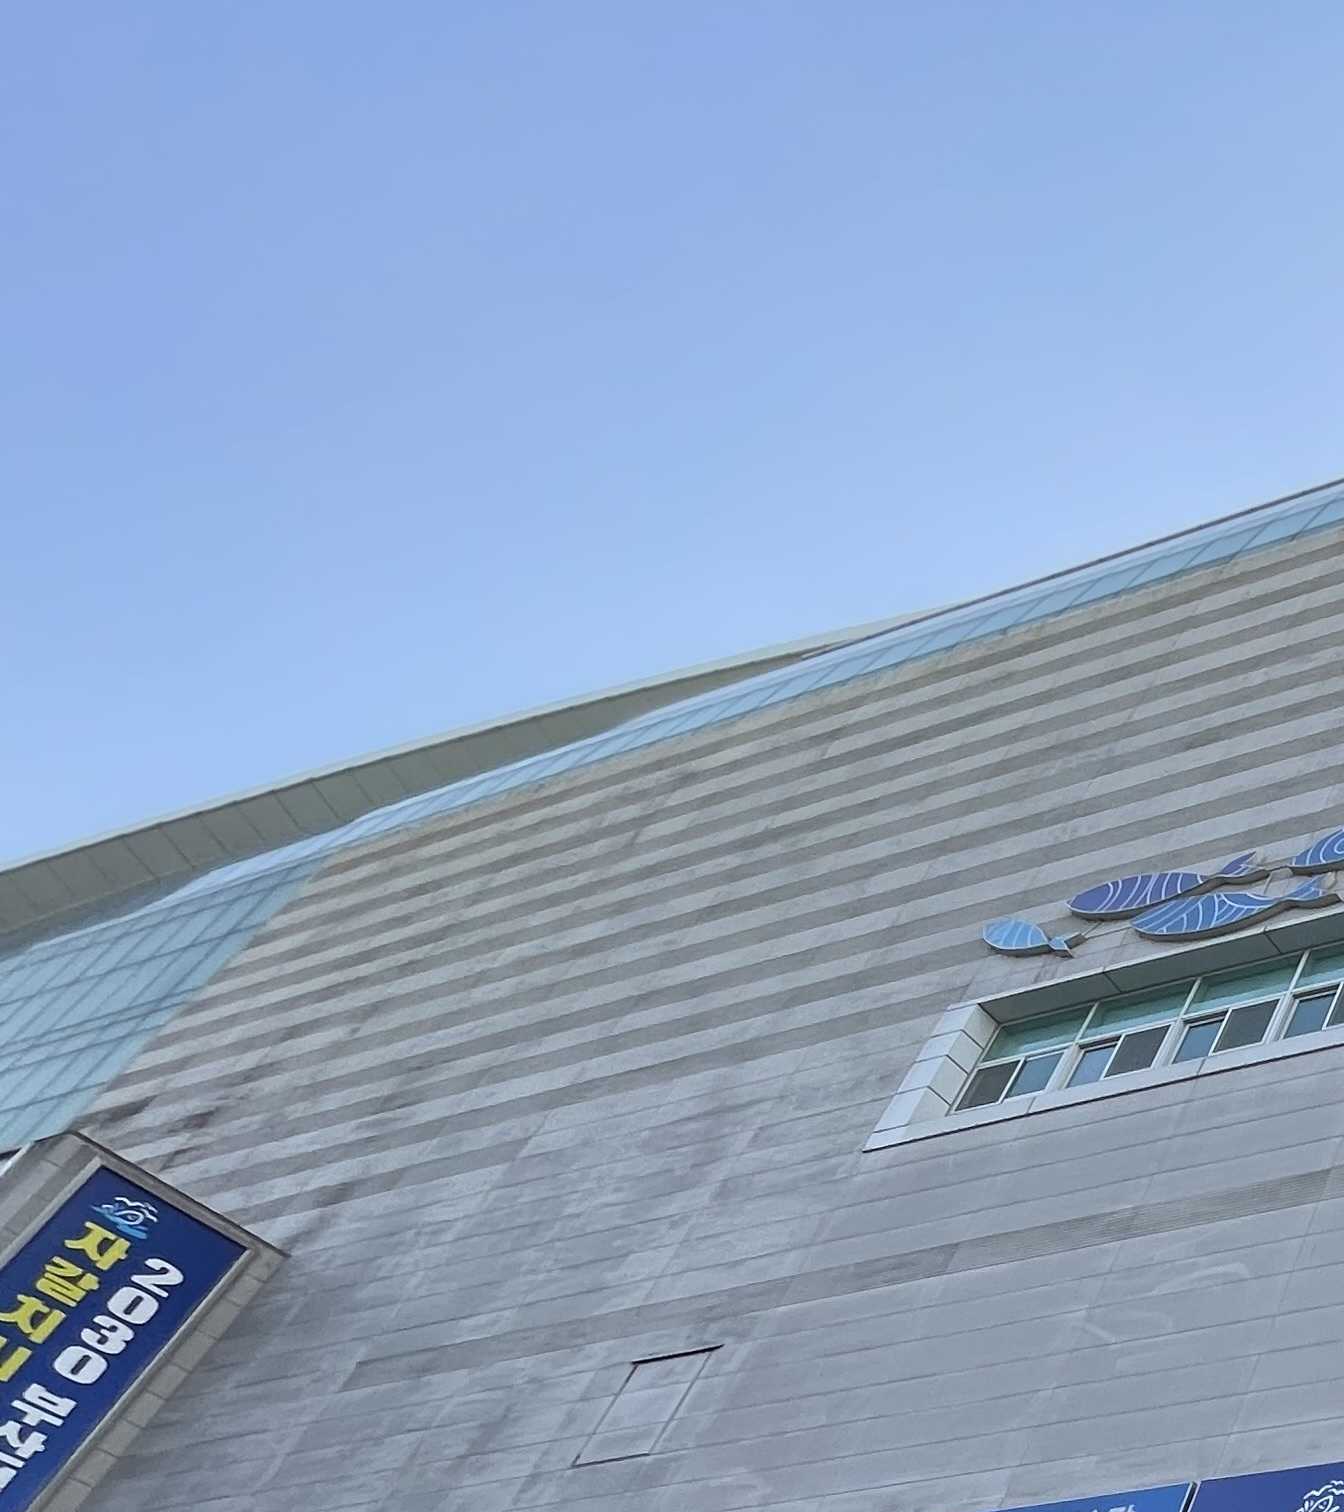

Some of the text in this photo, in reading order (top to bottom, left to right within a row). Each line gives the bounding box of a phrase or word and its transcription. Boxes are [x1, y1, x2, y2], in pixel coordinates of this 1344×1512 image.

[0, 1221, 131, 1382] 자갈치
[0, 1258, 184, 1491] 2030 부산
